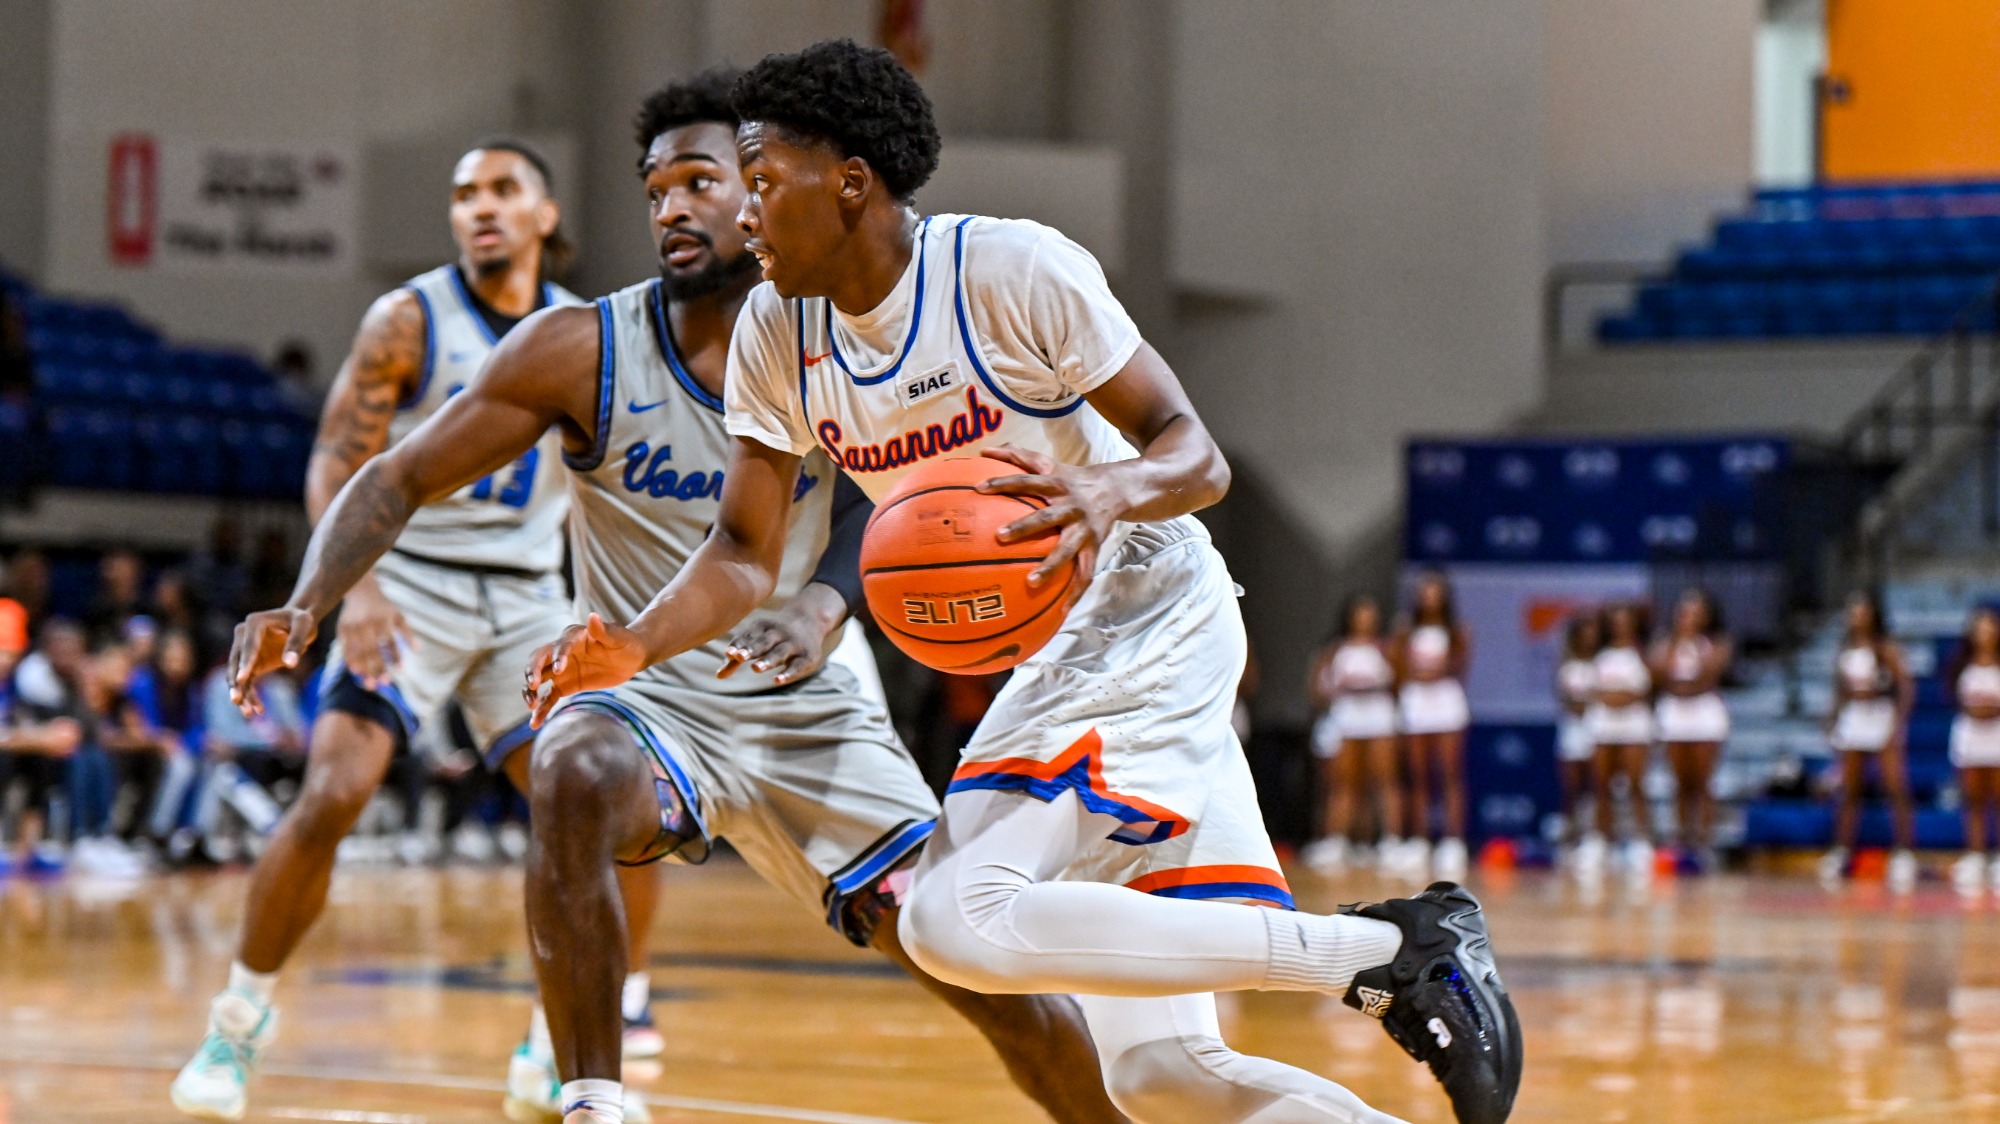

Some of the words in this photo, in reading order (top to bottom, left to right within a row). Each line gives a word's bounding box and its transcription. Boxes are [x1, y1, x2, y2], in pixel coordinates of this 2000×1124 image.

[908, 371, 951, 399] SIAC
[818, 385, 1003, 473] Savannah
[902, 594, 1005, 625] ELITE
